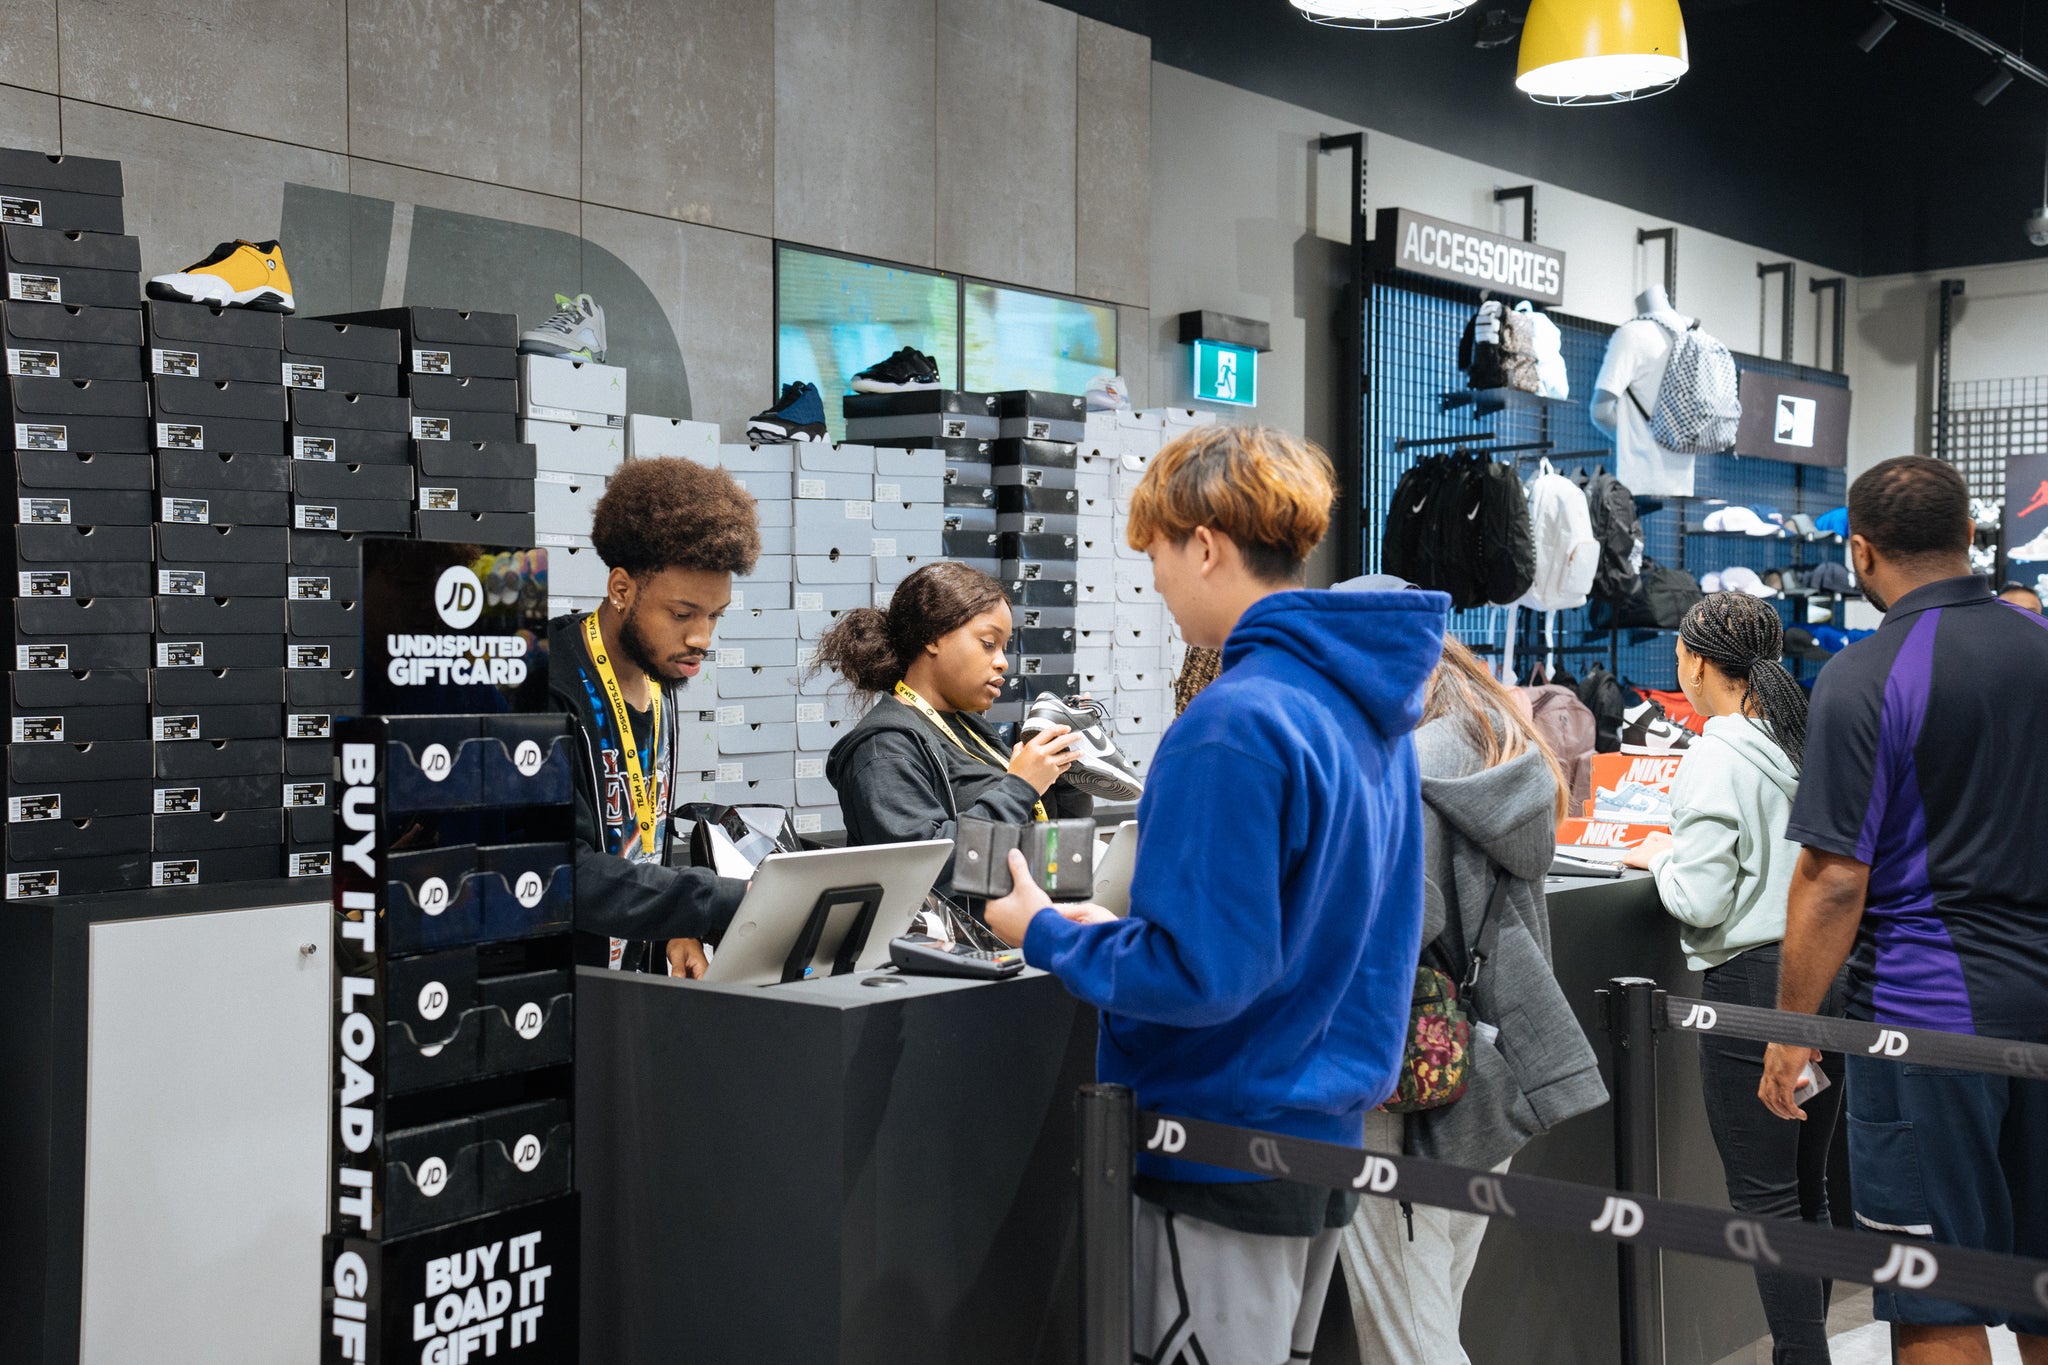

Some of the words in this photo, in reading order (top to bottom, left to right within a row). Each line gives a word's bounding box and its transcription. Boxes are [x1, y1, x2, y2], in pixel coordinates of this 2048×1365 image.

[1404, 222, 1560, 295] ACCESSORIES
[443, 582, 476, 612] JD
[387, 634, 528, 658] UNDISPUTED
[388, 658, 528, 686] GIFTCARD
[607, 678, 628, 734] JDSPORTS.CA
[632, 773, 639, 783] JD
[1626, 758, 1680, 782] NIKE
[342, 743, 376, 878] BUY
[634, 785, 644, 808] TEAM
[1581, 822, 1629, 845] NIKE
[342, 891, 376, 952] IT
[1682, 1004, 1718, 1030] JD
[1868, 1029, 1909, 1056] JD
[340, 976, 376, 1154] LOAD
[1146, 1118, 1186, 1153] JD
[1352, 1155, 1398, 1192] JD
[339, 1167, 374, 1231] IT
[1590, 1196, 1644, 1237] JD
[426, 1241, 503, 1298] BUY
[509, 1230, 542, 1274] IT
[1872, 1243, 1938, 1290] JD
[332, 1251, 368, 1365] GIF
[413, 1279, 512, 1342] LOAD
[519, 1265, 552, 1308] IT
[420, 1317, 504, 1365] GIFT
[510, 1305, 544, 1349] IT
